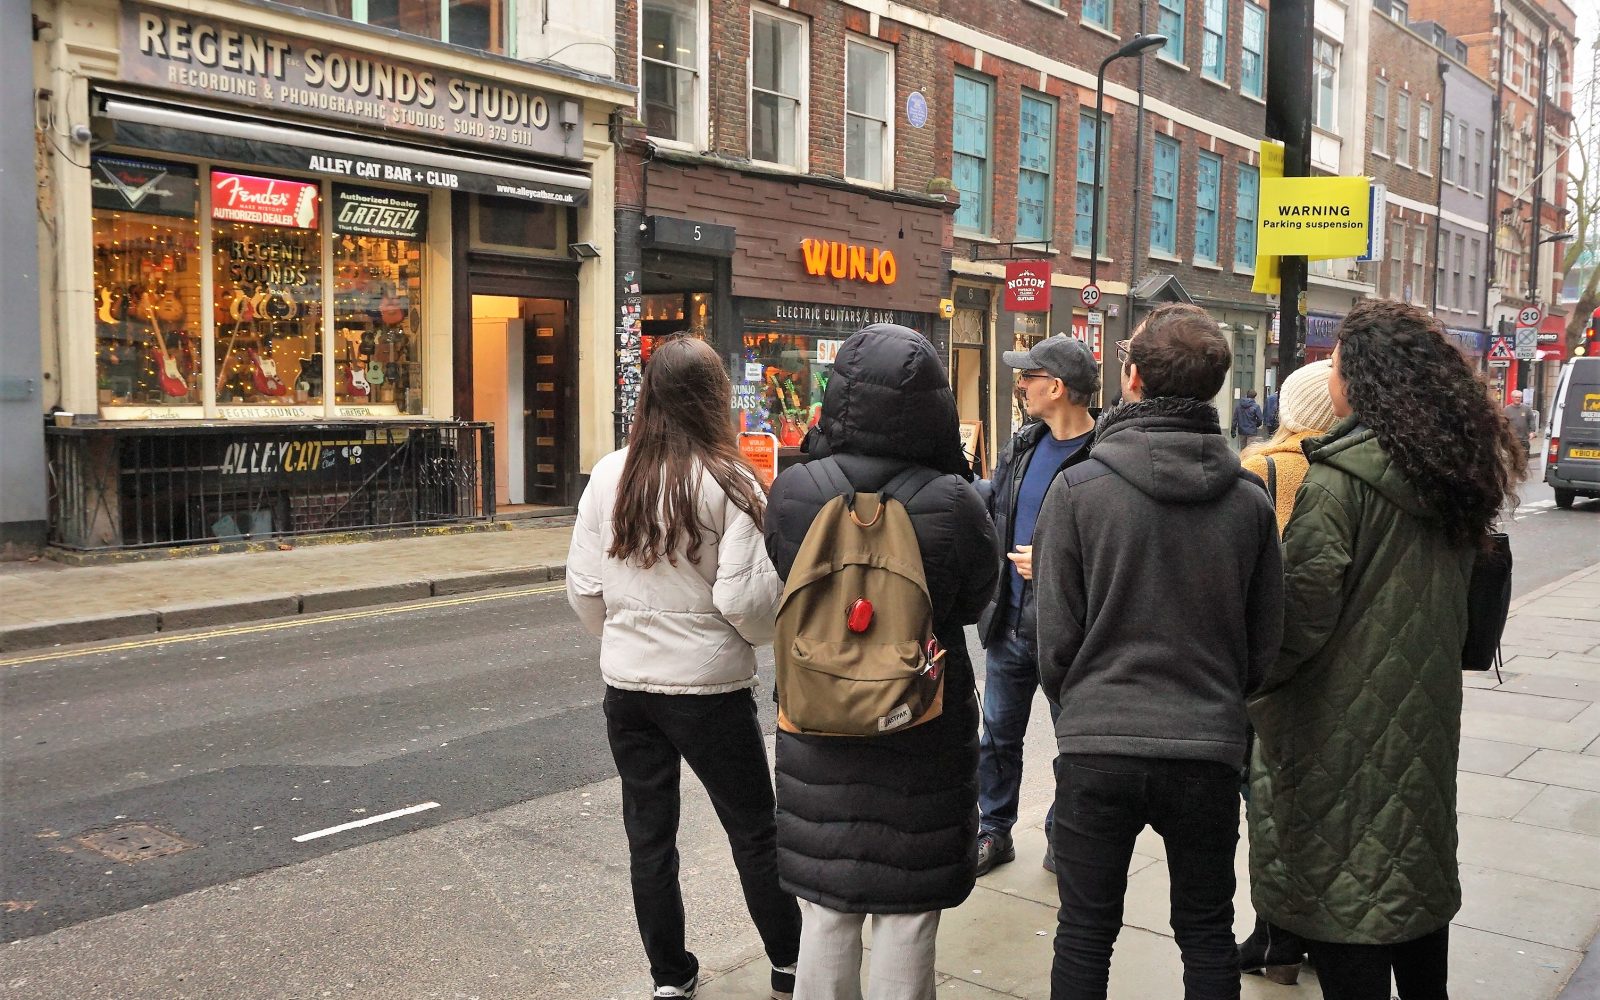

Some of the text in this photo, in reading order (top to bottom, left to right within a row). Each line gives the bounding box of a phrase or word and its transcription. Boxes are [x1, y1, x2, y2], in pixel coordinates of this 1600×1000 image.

[138, 12, 291, 79] REGENT
[303, 46, 436, 109] SOUNDS
[448, 78, 549, 129] STUDIO
[168, 65, 257, 98] RECORDING
[263, 83, 274, 100] &
[280, 85, 387, 120] PHONOGRAPHIC
[392, 106, 446, 131] STUDIOS
[454, 117, 485, 138] SOHO
[489, 124, 508, 142] 379
[309, 155, 353, 174] ALLEY
[356, 161, 382, 178] CAT
[384, 165, 412, 182] BAR
[427, 170, 459, 188] CLUB
[216, 177, 289, 206] Fender
[340, 192, 418, 208] Authorized Dealer
[496, 184, 574, 203] www.alleycatbar.co.uk
[213, 207, 293, 225] AUTHORIZED DEALER
[338, 202, 420, 230] GRETSCH
[1278, 206, 1350, 216] WARNING
[693, 225, 702, 241] 5
[1263, 220, 1363, 229] Parking suspension
[229, 240, 305, 263] REGENT
[800, 238, 897, 285] WUNJO
[229, 263, 307, 286] SOUNDS
[1007, 278, 1046, 289] NO.TOM
[1083, 290, 1098, 300] 20
[776, 305, 820, 320] ELECTRIC
[824, 309, 861, 323] GUITARS
[874, 311, 895, 324] BASS
[1522, 311, 1539, 321] 30
[731, 396, 756, 409] BASS
[218, 407, 305, 418] REGENT SOUNDS
